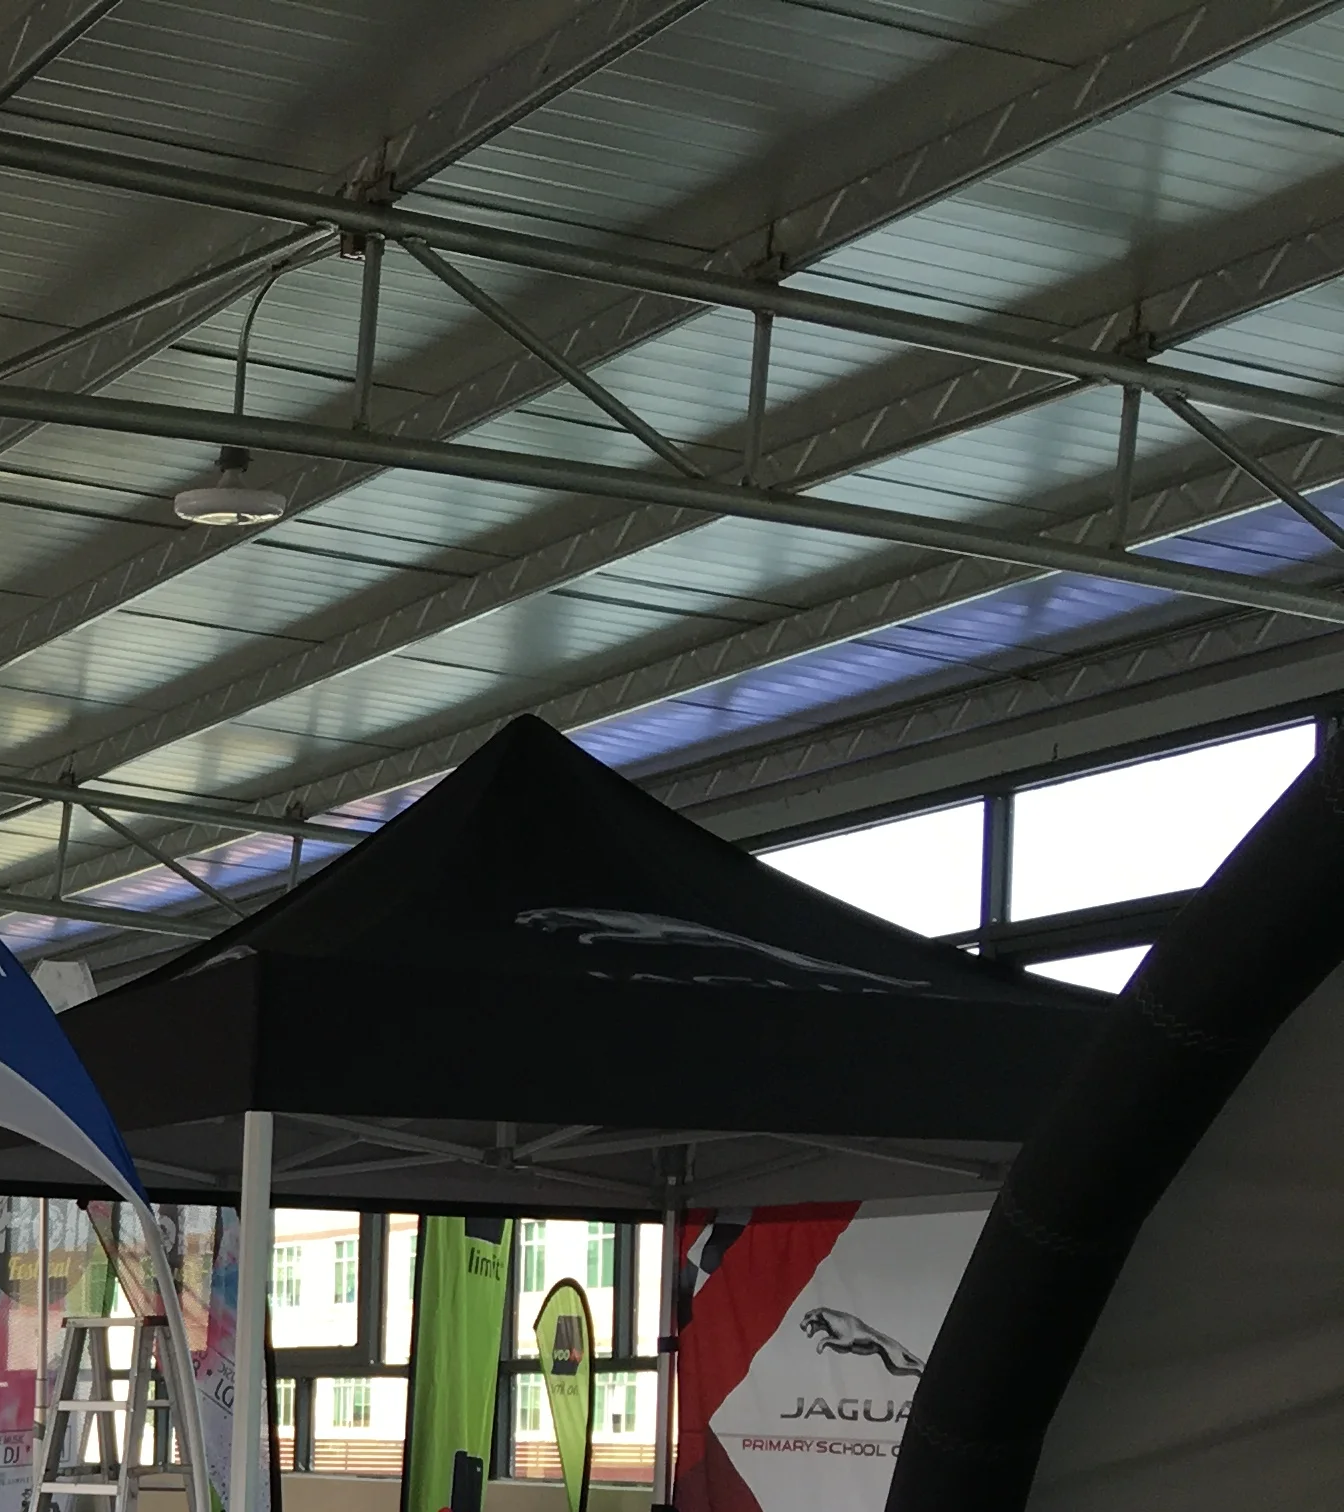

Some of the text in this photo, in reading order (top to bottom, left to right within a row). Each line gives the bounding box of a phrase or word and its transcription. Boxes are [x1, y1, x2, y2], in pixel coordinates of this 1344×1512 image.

[467, 1246, 502, 1281] limit
[780, 1396, 913, 1423] JAGUA
[3, 1446, 20, 1464] DJ
[742, 1438, 812, 1453] PRIMARY
[816, 1440, 887, 1457] SCHOOL
